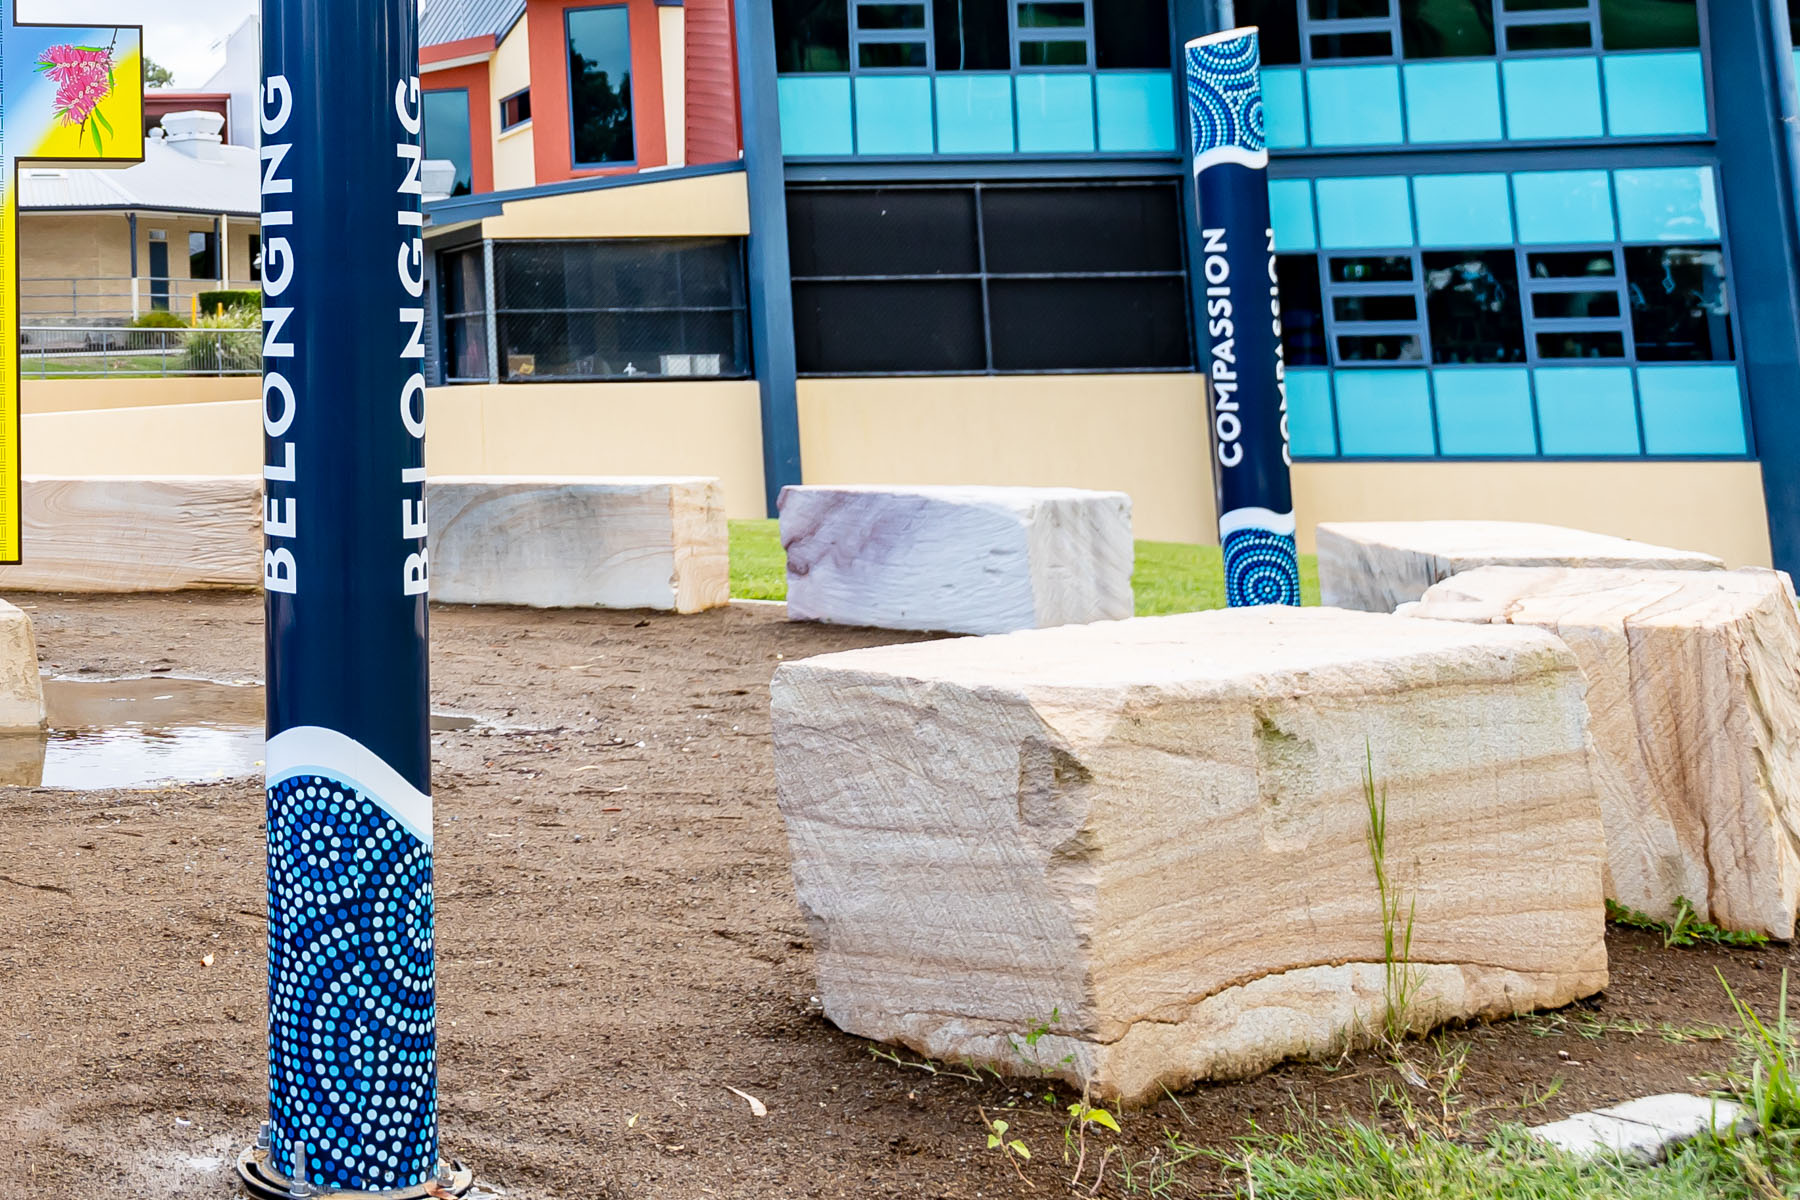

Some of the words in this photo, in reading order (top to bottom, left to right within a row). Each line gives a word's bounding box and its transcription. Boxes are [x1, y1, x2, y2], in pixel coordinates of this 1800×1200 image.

[260, 74, 297, 595] BELONGING
[395, 76, 429, 596] BELONGING
[1202, 227, 1243, 467] COMPASSION
